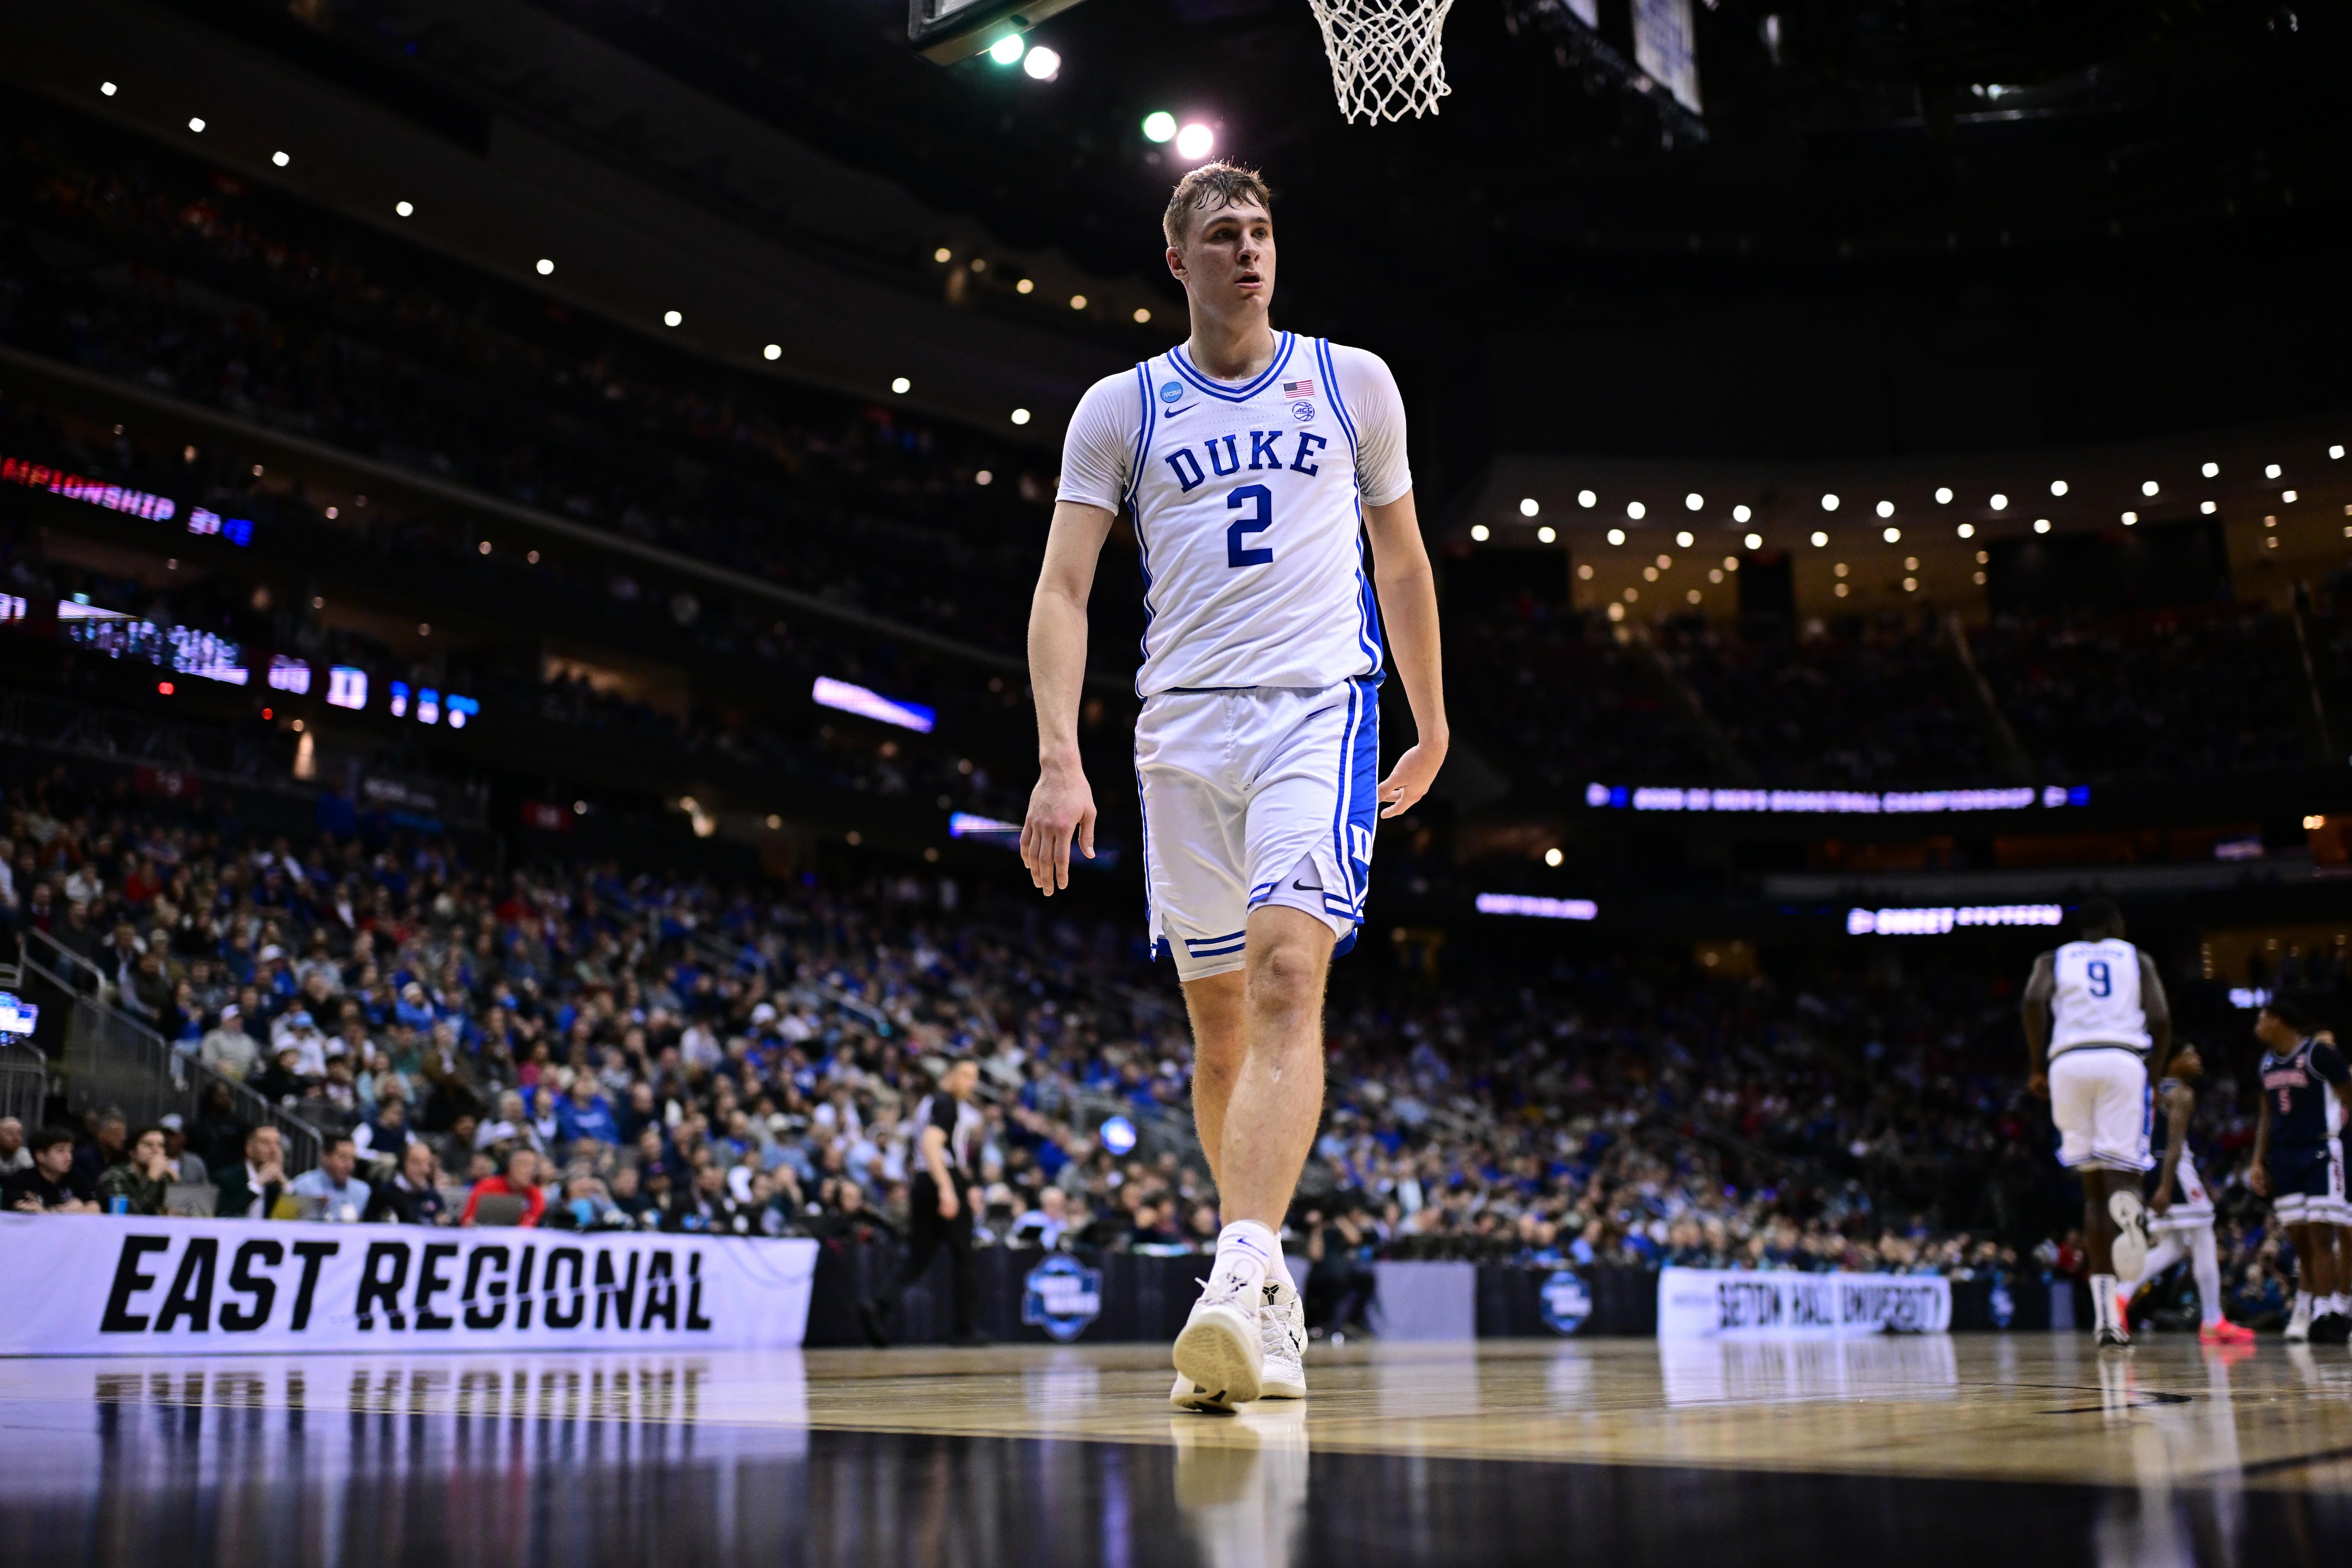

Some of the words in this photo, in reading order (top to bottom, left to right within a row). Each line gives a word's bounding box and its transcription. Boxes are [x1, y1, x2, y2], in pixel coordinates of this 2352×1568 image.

[1163, 389, 1181, 398] NCAA
[1165, 431, 1327, 493] DUKE
[1227, 484, 1273, 568] 2
[2088, 962, 2111, 997] 9
[100, 1235, 339, 1332] EAST
[355, 1242, 712, 1331] REGIONAL
[1717, 1281, 1782, 1329] SETON
[1792, 1283, 1833, 1326] HALL
